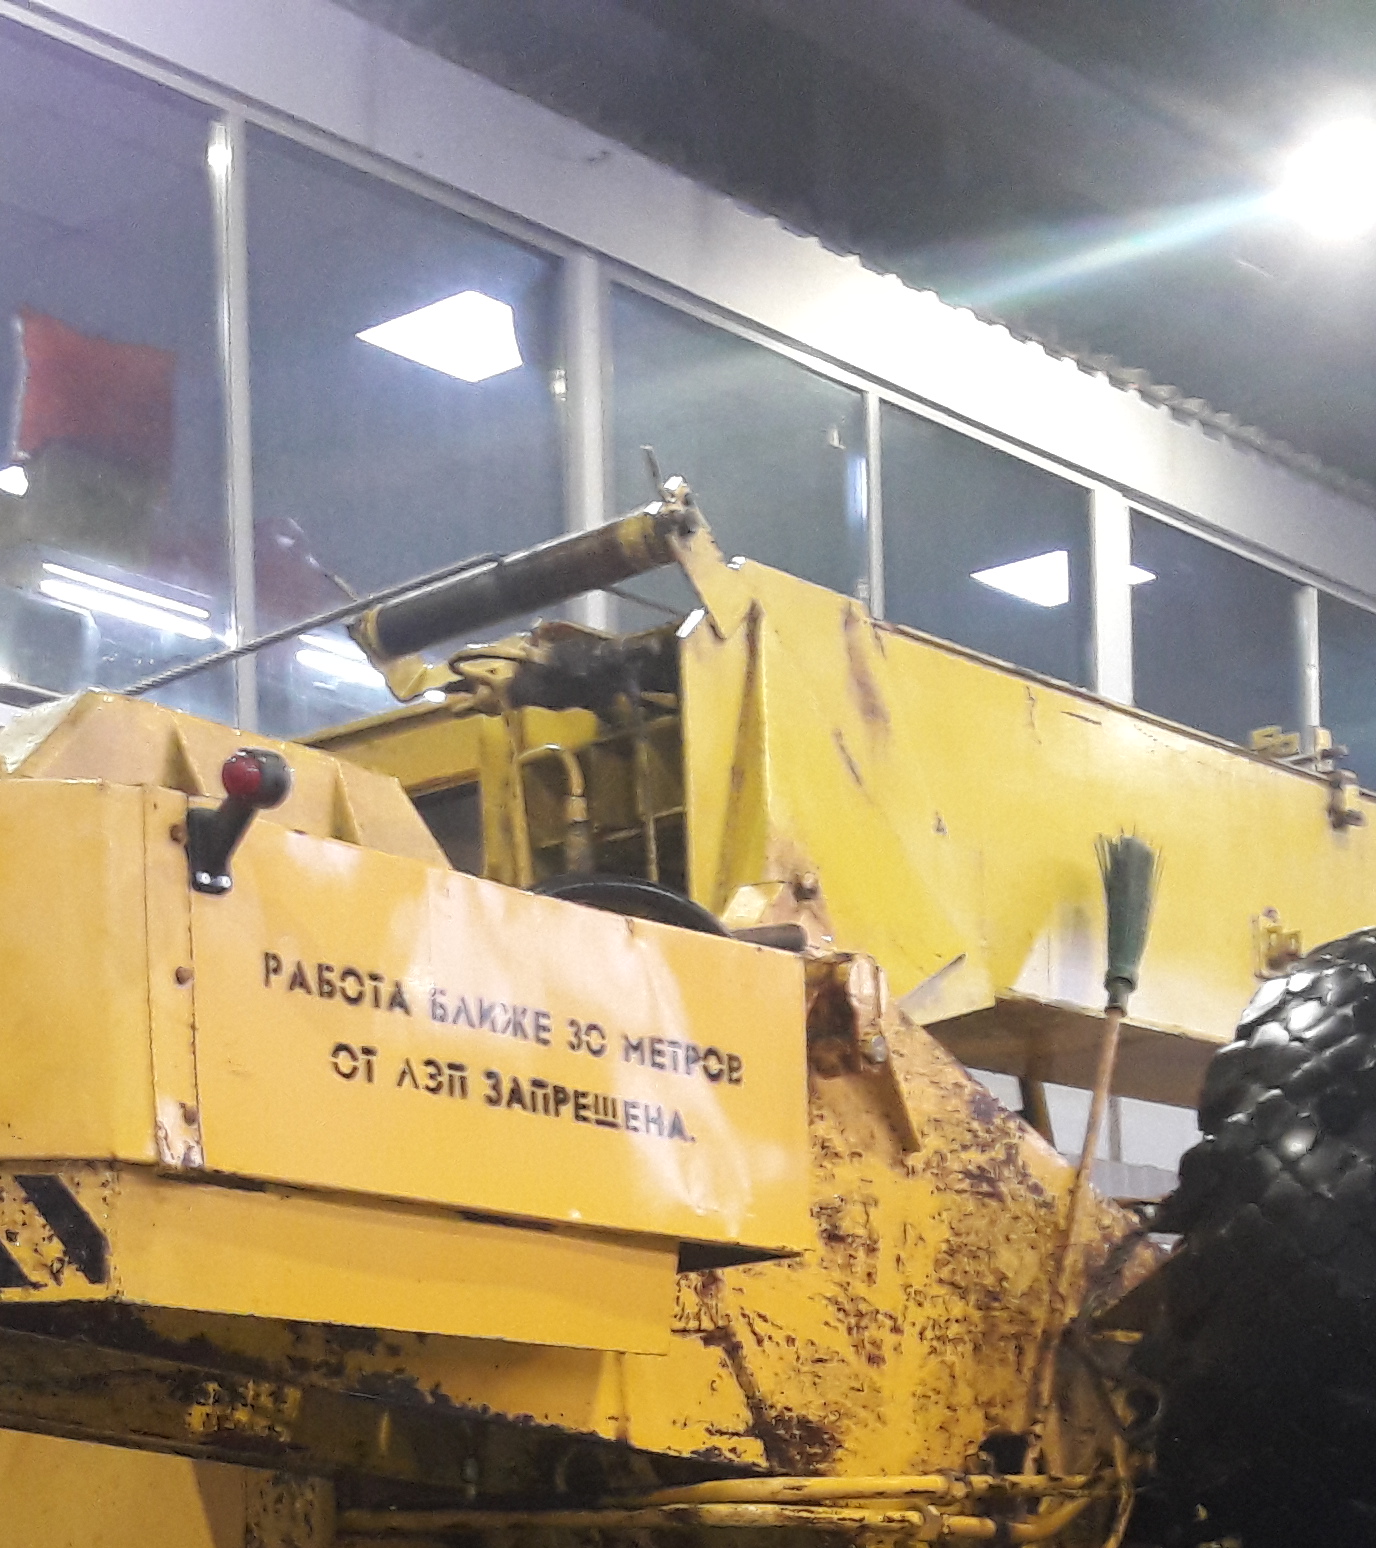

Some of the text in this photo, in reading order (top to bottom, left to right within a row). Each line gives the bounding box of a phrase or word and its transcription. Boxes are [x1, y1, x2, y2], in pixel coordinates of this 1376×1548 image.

[263, 950, 412, 1018] РАБОТА
[430, 987, 551, 1047] БЛИЖЕ
[622, 1033, 744, 1085] МЕТРОВ
[330, 1042, 378, 1083] ОТ
